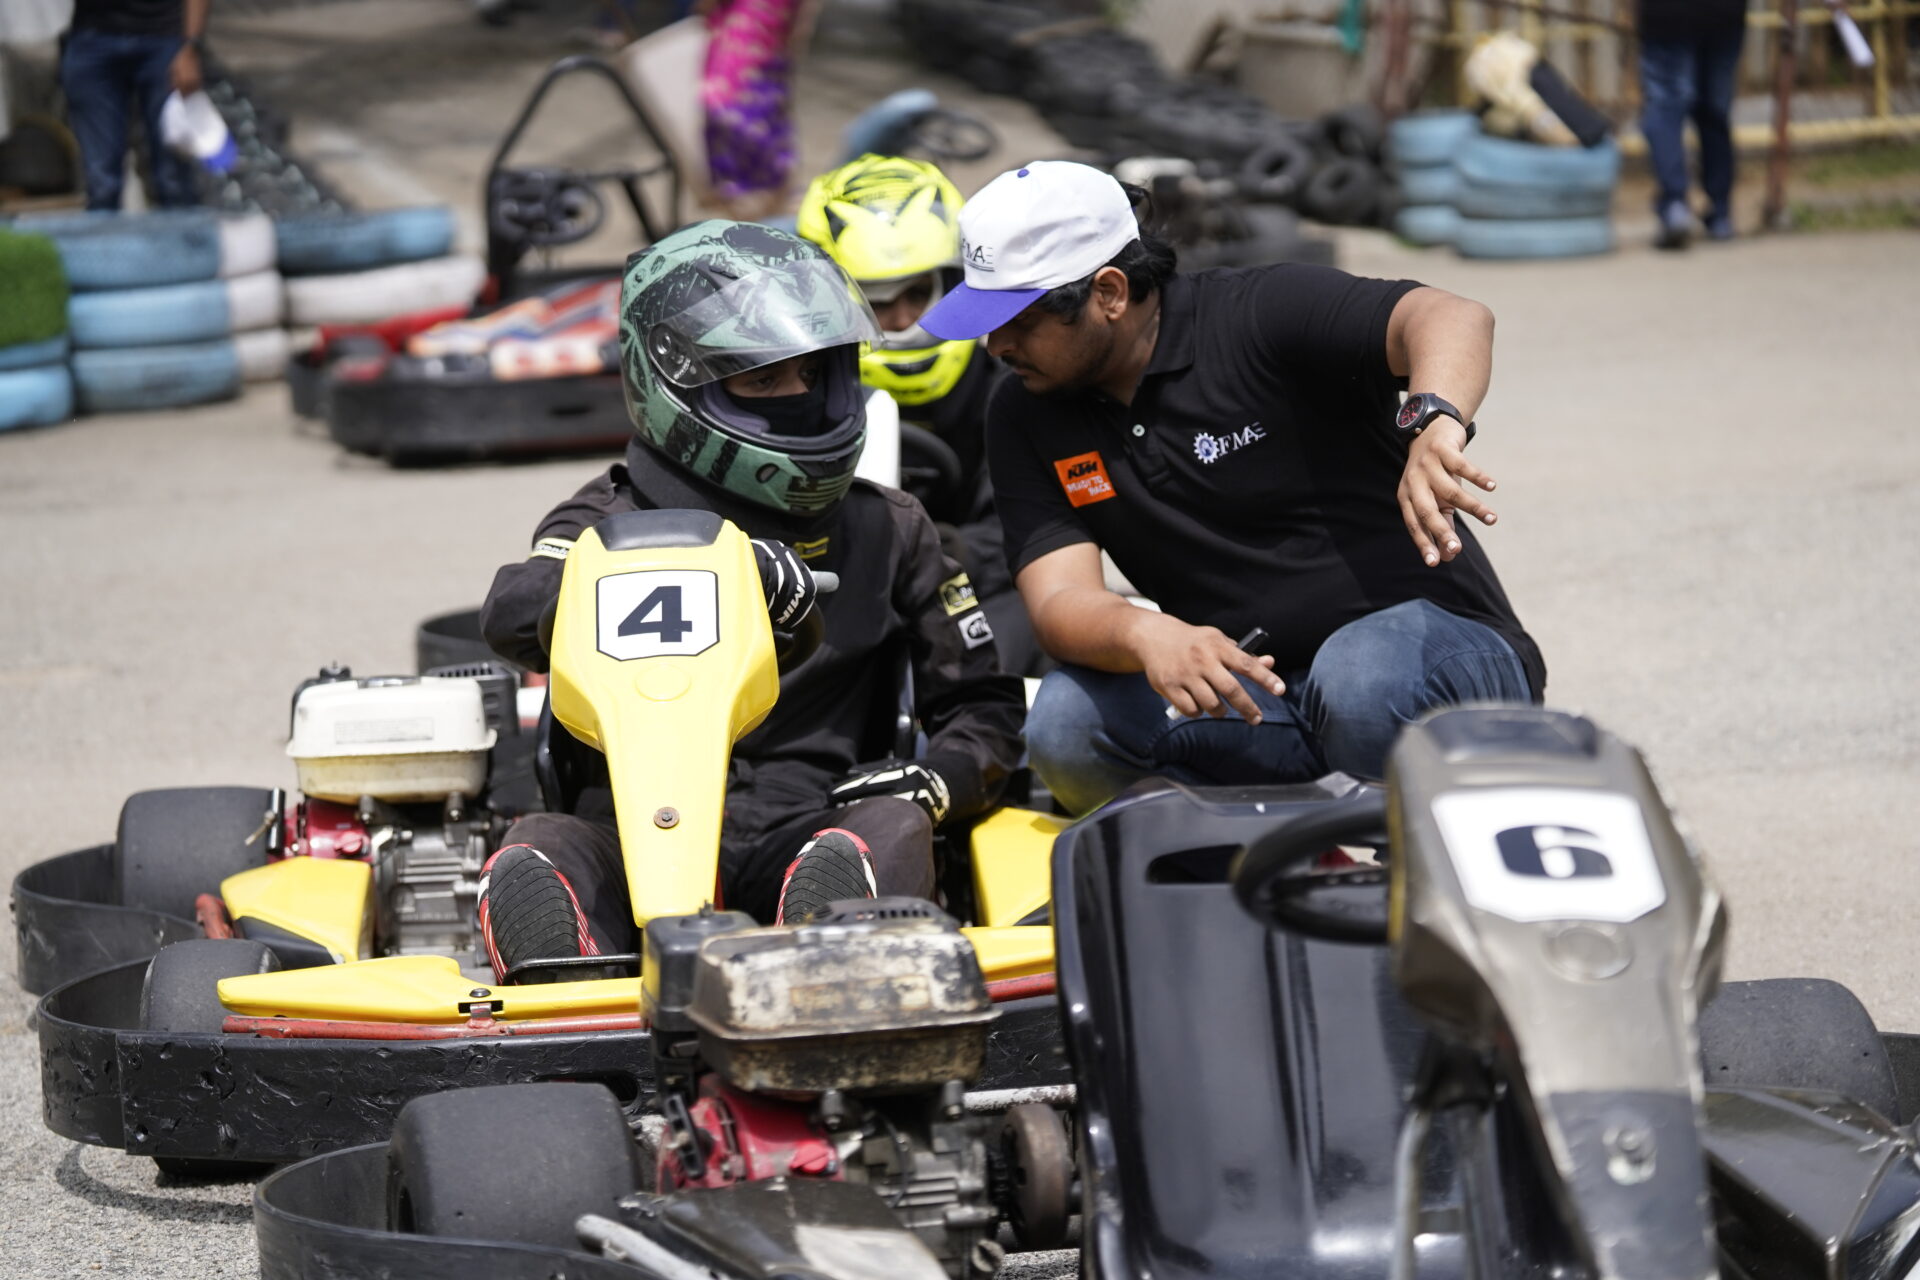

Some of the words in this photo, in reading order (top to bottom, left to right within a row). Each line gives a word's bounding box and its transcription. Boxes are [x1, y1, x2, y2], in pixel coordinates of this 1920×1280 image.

[1067, 460, 1098, 480] KTM
[617, 585, 693, 643] 4
[1495, 824, 1614, 879] 6
